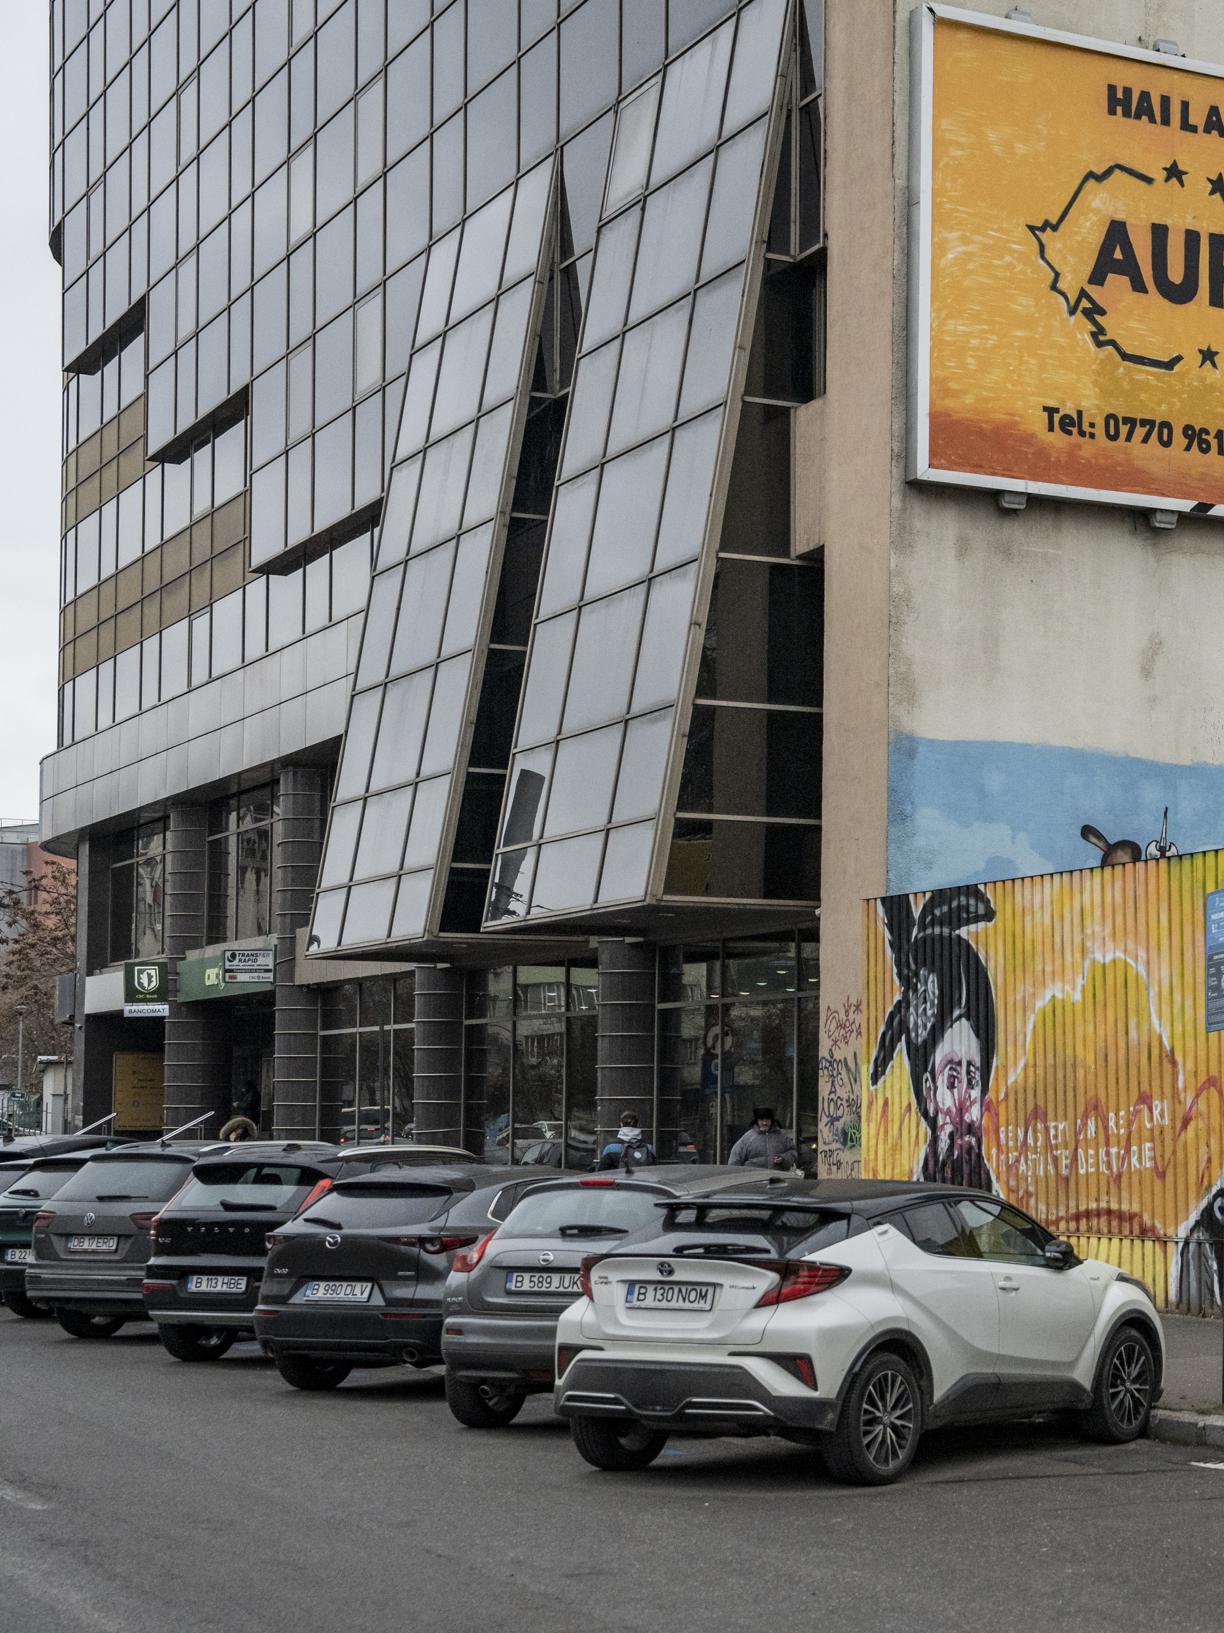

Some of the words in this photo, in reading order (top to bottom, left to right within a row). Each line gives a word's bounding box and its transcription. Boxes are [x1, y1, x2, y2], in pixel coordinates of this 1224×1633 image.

[1042, 405, 1096, 439] Tel:
[1104, 413, 1174, 448] 0770
[1182, 424, 1224, 456] 961
[10, 1250, 16, 1260] B
[18, 1250, 31, 1260] 22
[195, 1277, 203, 1289] B
[206, 1277, 218, 1289] 113
[221, 1278, 245, 1290] HBE
[515, 1275, 524, 1288] B
[529, 1275, 552, 1289] 589
[555, 1275, 581, 1290] JUK
[311, 1283, 320, 1296] B
[322, 1283, 343, 1296] 990
[344, 1284, 369, 1297] DLV
[636, 1286, 647, 1302] B
[653, 1286, 675, 1303] 130
[676, 1287, 709, 1304] NOM
